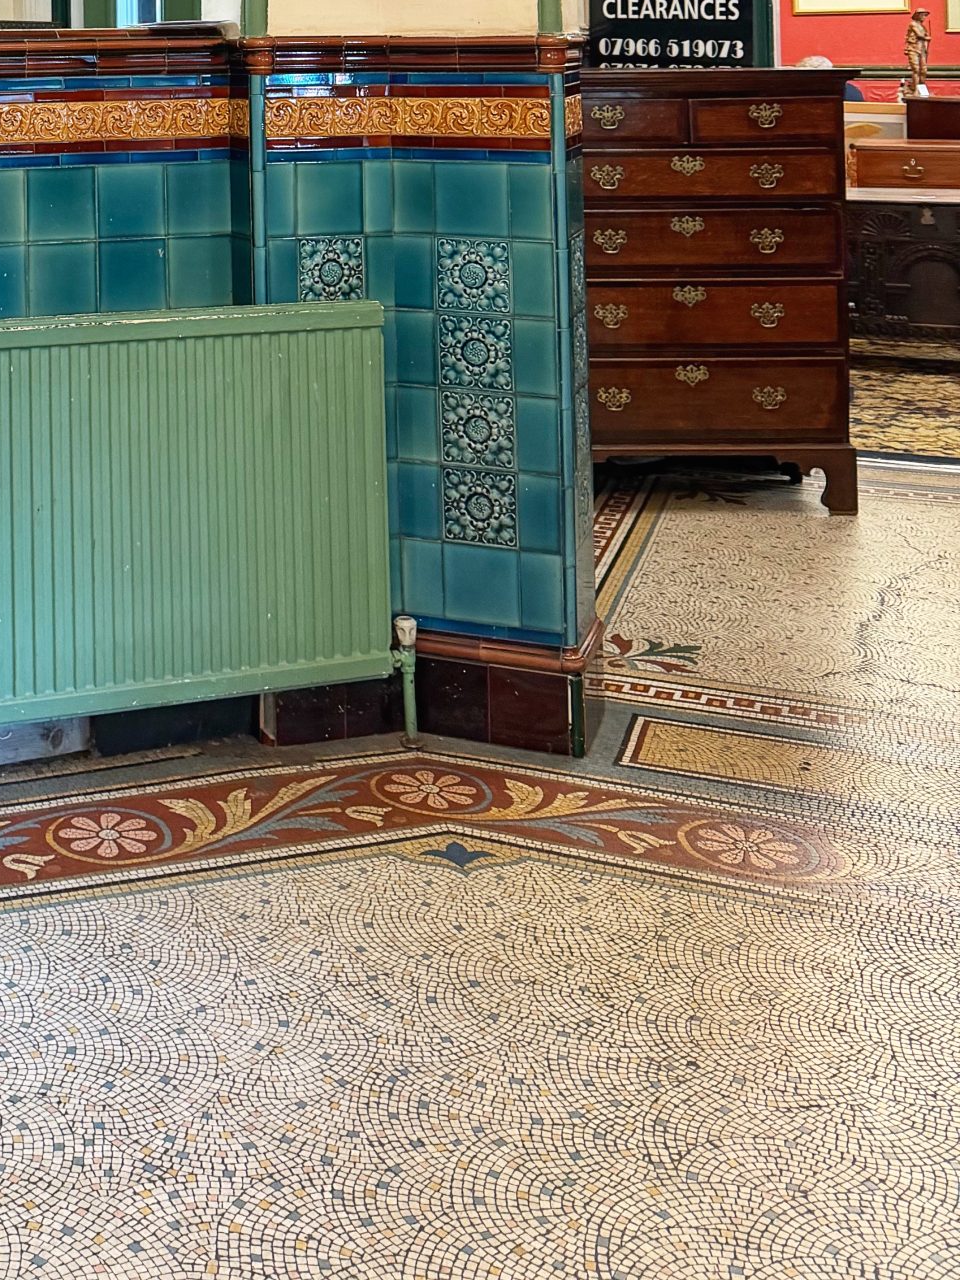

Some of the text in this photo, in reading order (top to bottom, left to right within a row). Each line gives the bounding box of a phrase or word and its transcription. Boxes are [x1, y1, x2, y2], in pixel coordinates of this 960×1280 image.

[603, 0, 739, 20] CLEARANCES
[599, 38, 743, 58] 07966 519073
